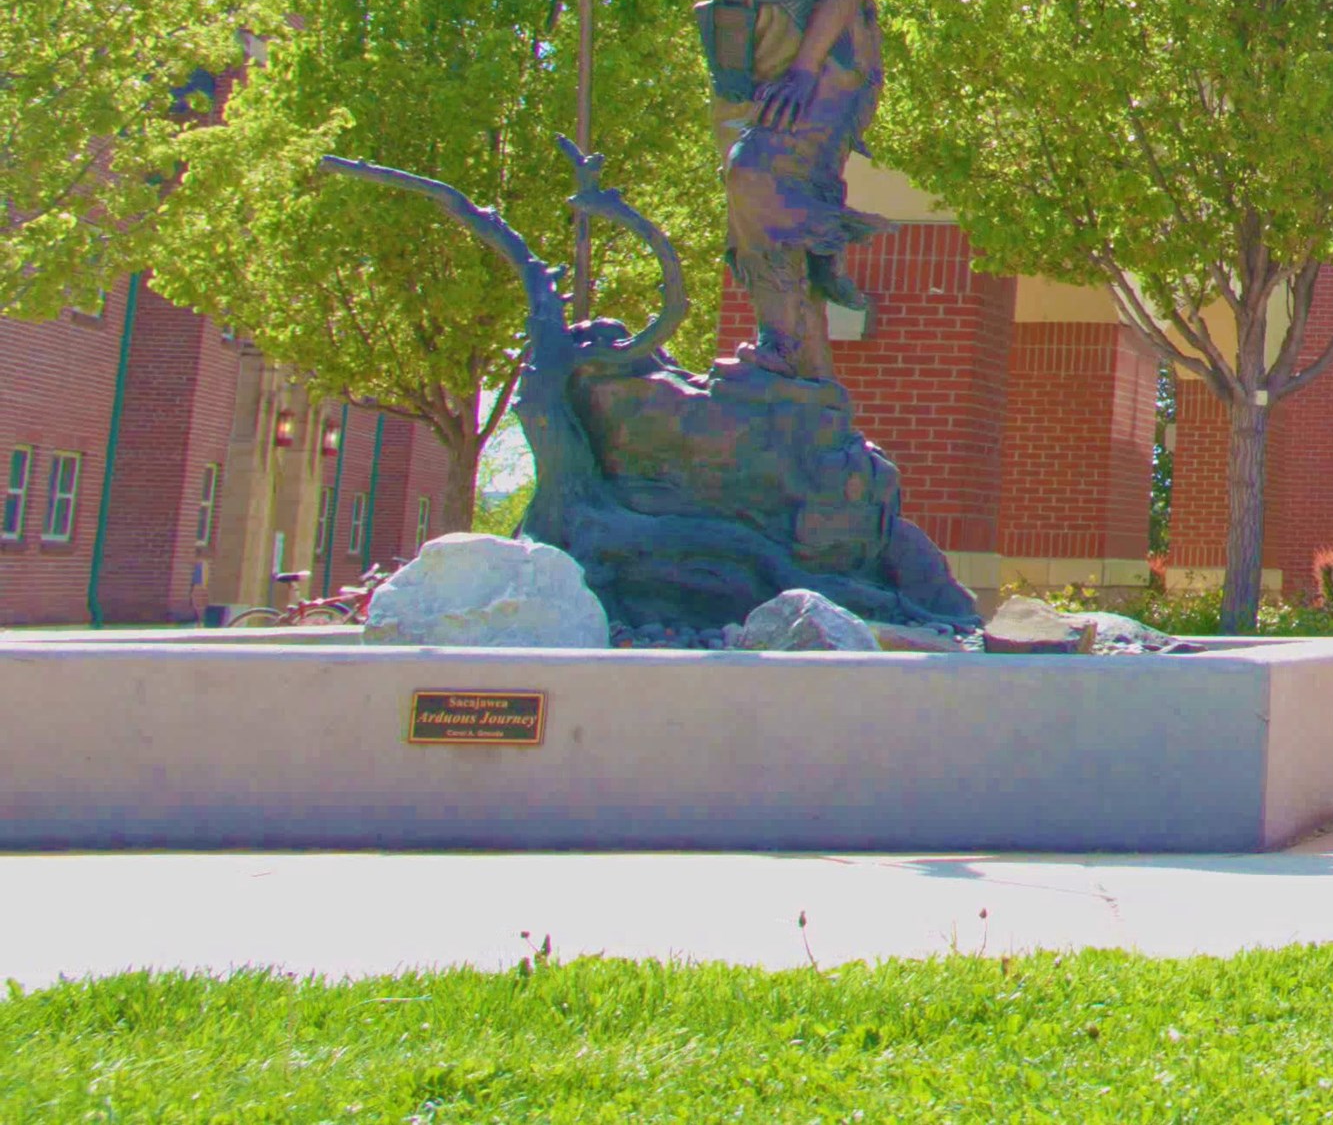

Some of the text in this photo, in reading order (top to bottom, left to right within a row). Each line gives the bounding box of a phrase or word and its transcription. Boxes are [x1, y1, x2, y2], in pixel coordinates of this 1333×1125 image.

[449, 697, 508, 709] Sacajawea
[417, 711, 537, 727] Arduous Journey
